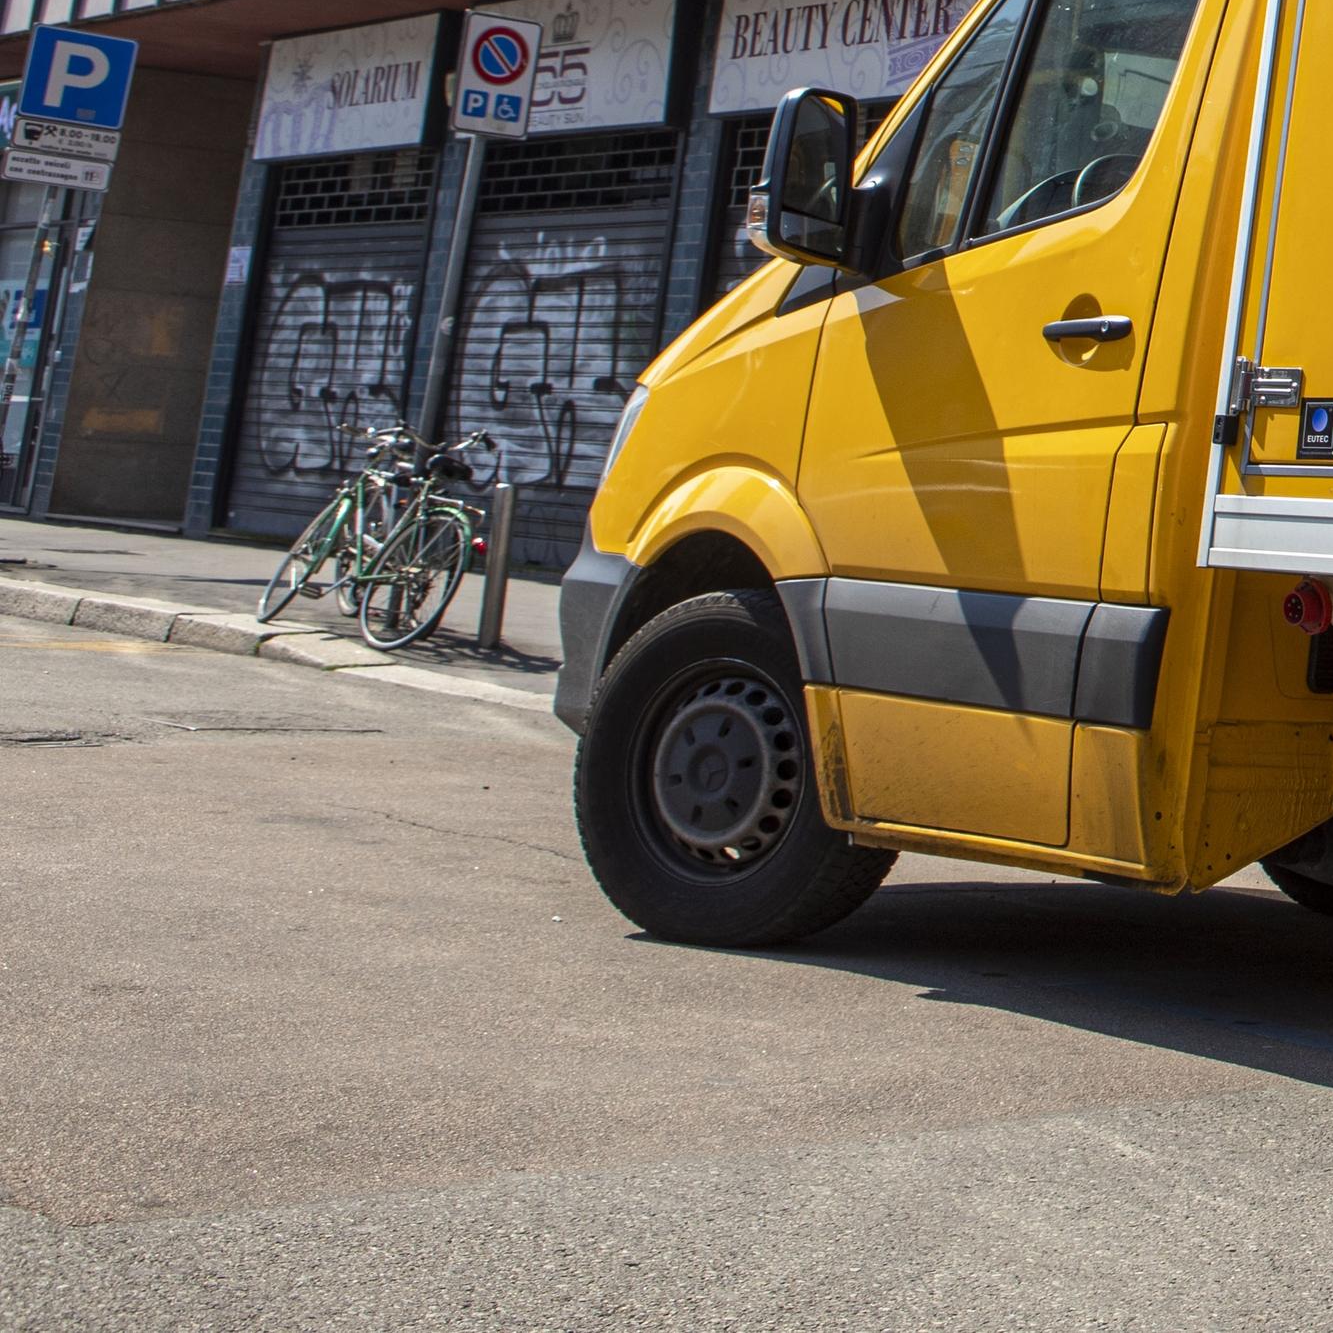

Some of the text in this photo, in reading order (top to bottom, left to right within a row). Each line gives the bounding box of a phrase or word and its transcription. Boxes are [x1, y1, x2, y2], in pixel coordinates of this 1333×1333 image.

[731, 1, 838, 60] BEAUTY
[43, 40, 110, 108] P
[327, 61, 421, 110] SOLARIUM
[467, 93, 483, 113] P
[1307, 435, 1329, 443] EUTEC
